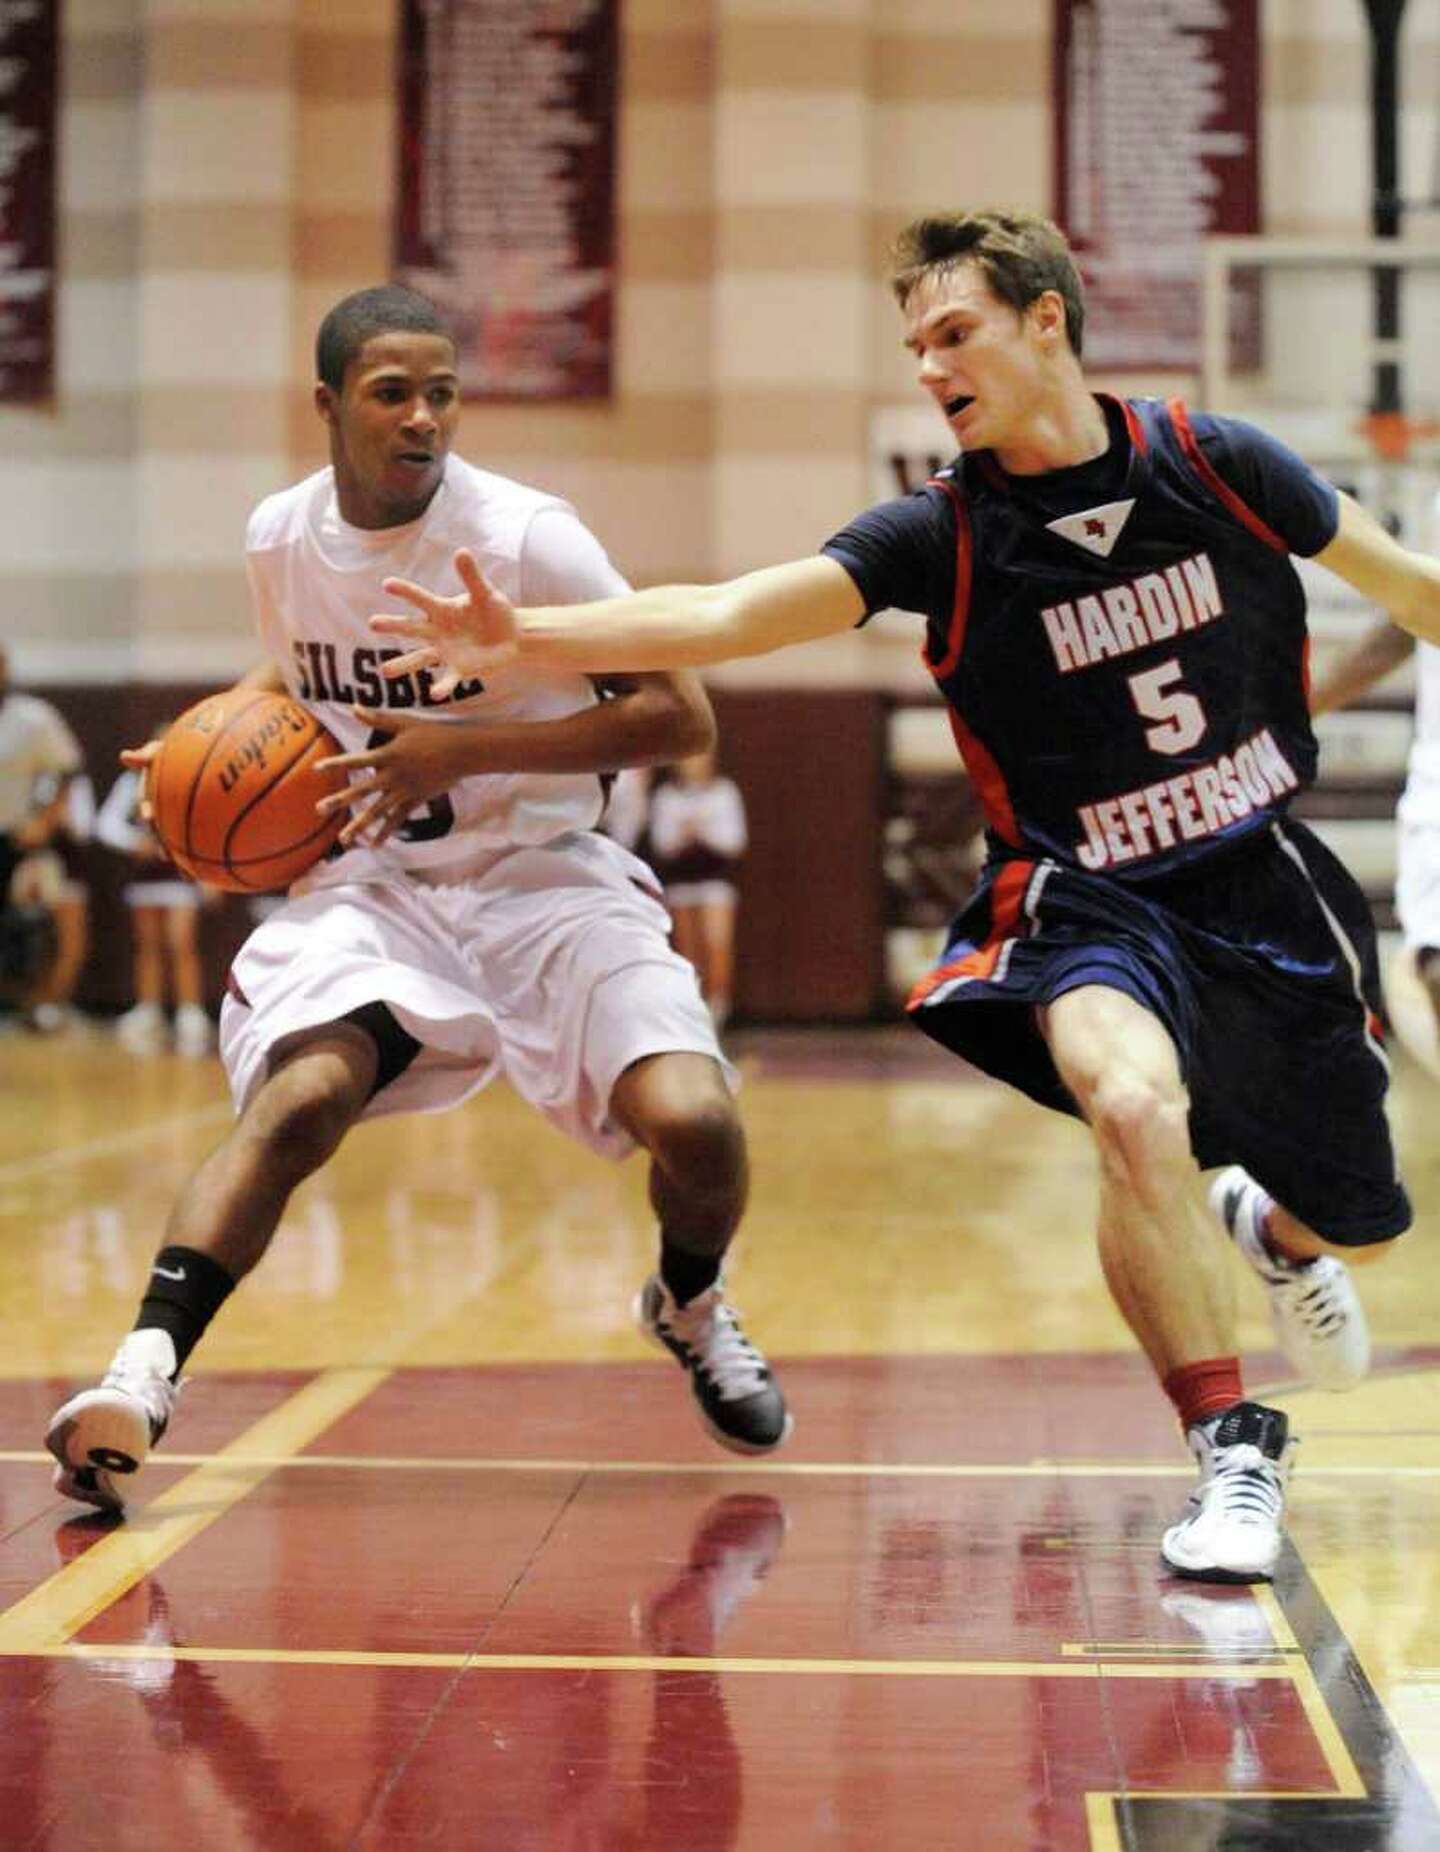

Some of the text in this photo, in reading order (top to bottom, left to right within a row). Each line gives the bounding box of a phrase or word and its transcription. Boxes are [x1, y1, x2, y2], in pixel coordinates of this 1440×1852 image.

[1041, 552, 1225, 674] HARDIN
[1127, 657, 1208, 757] 5
[1074, 728, 1299, 871] JEFFERSON
